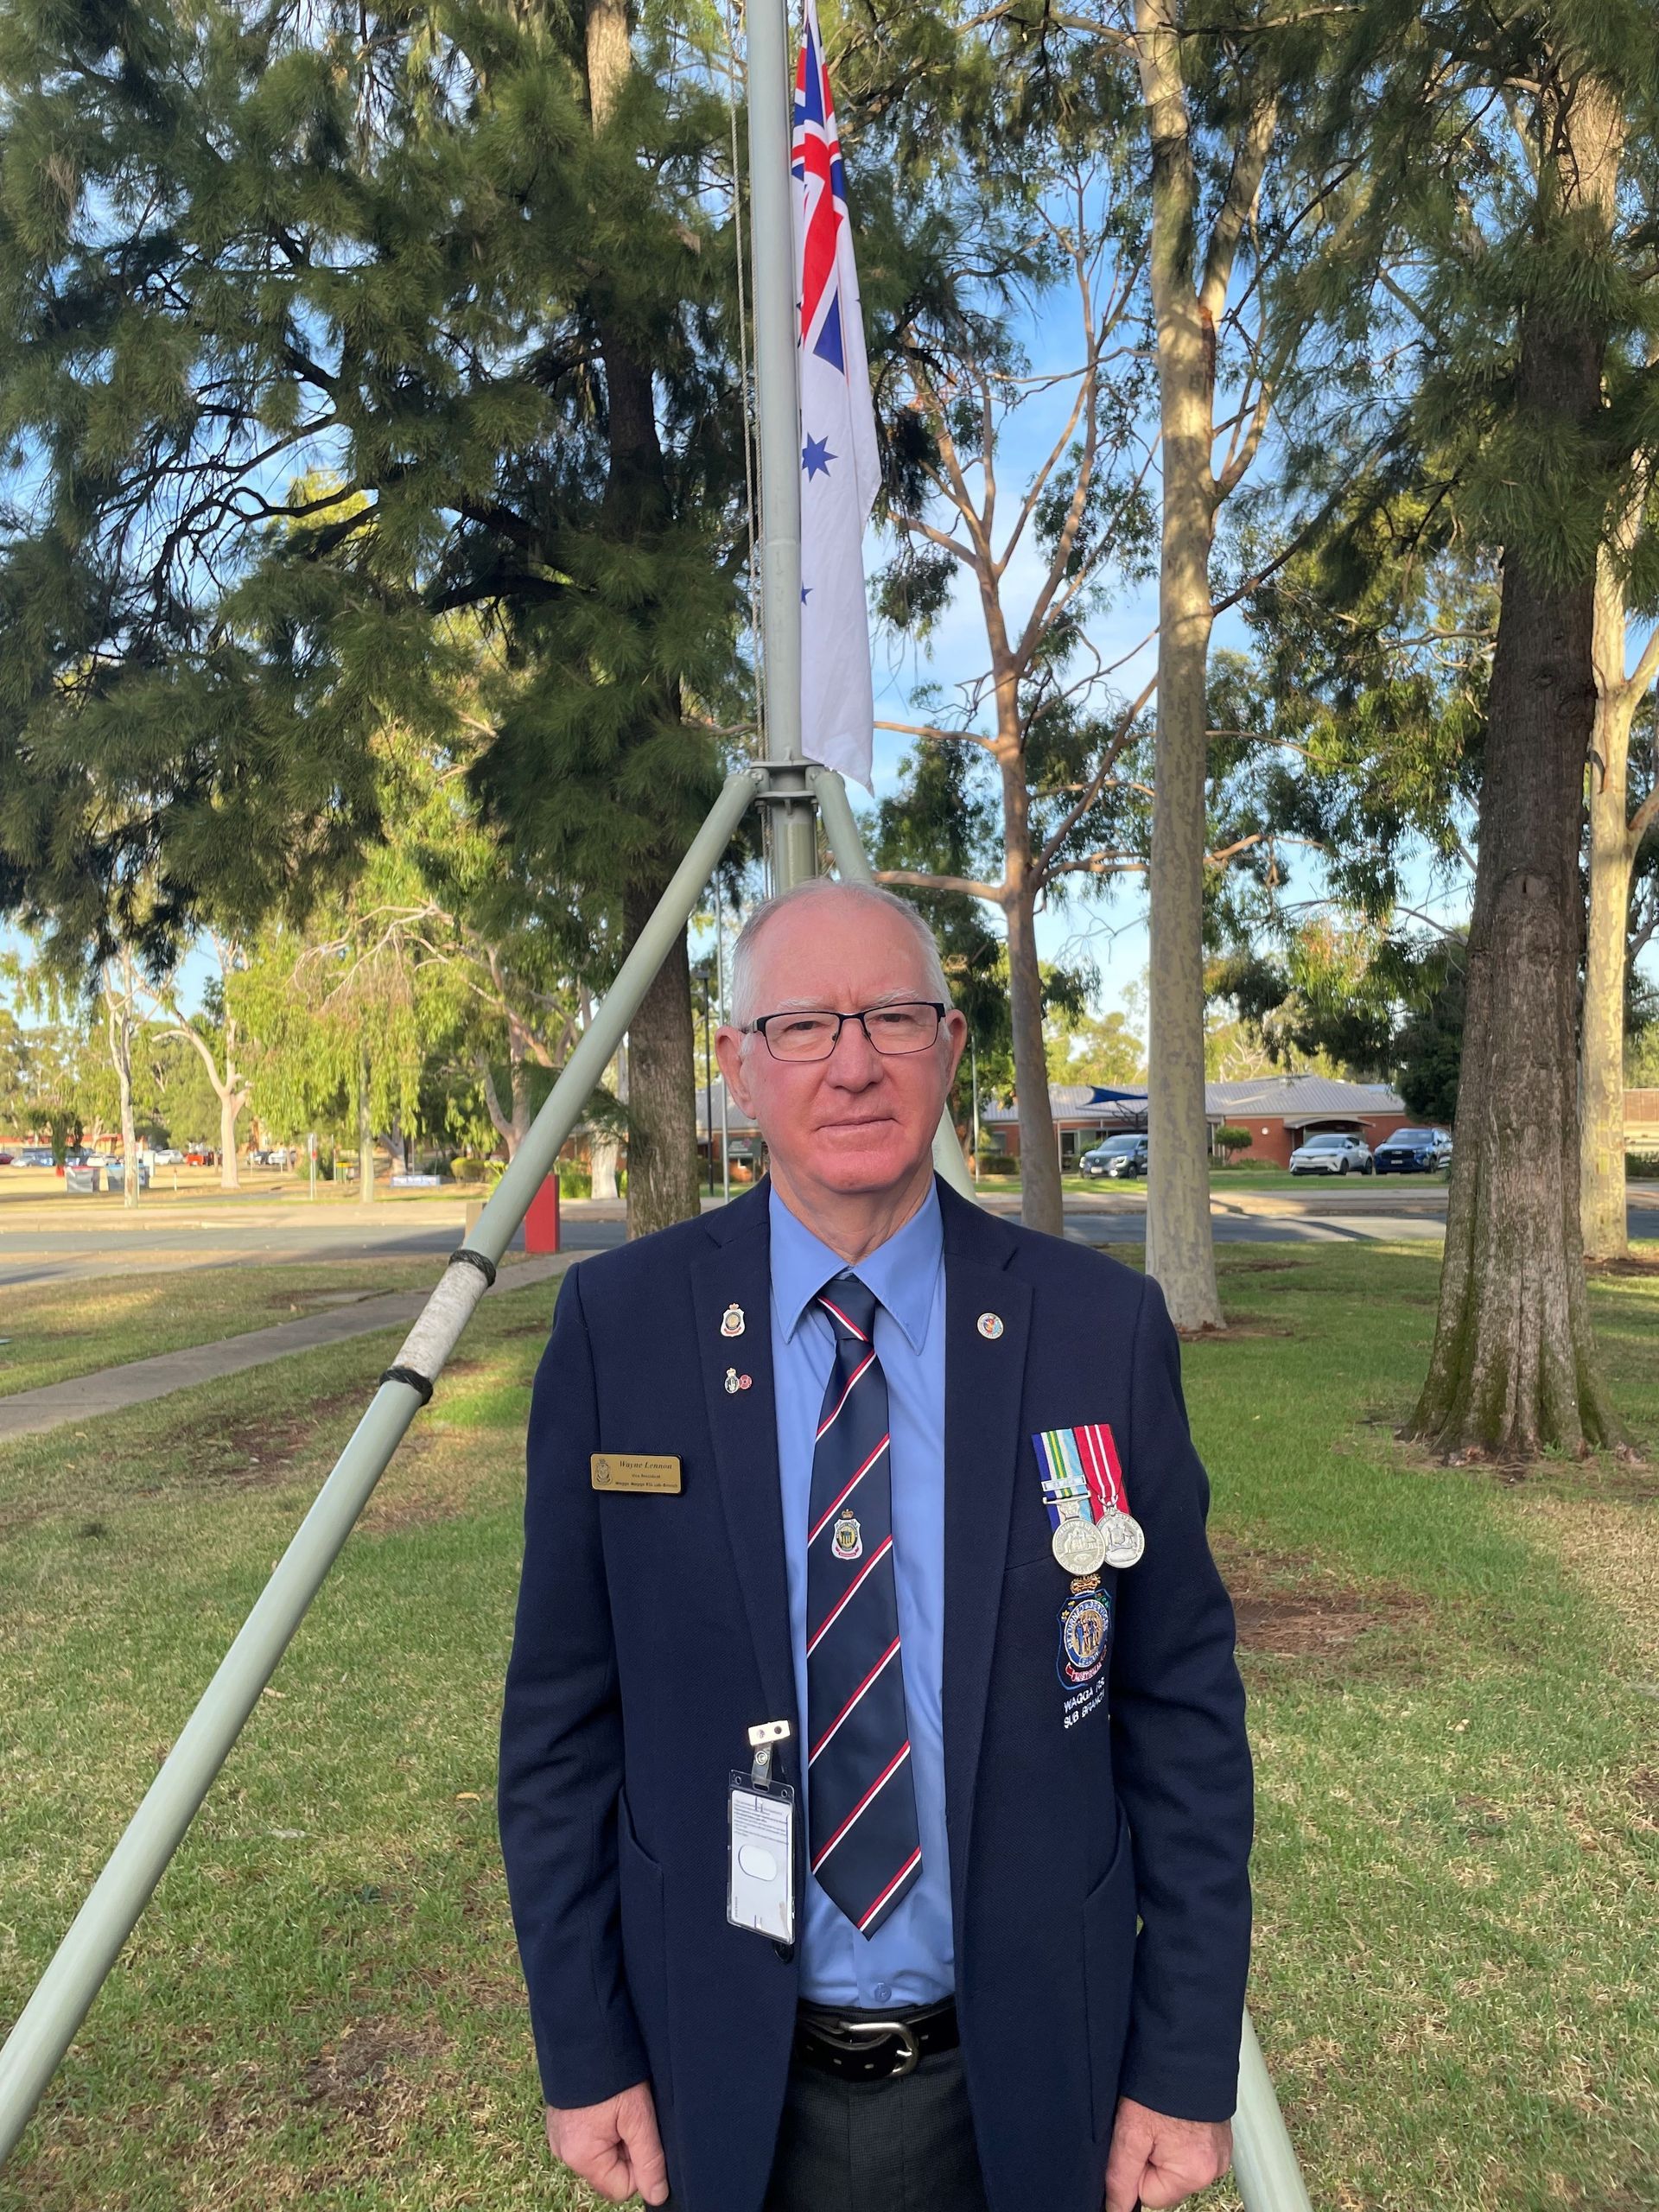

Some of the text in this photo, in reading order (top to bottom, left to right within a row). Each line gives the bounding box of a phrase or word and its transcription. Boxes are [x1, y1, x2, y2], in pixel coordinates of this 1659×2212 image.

[620, 1460, 672, 1470] Wayne Lennon
[1064, 1676, 1105, 1714] WAGGA RS
[1064, 1688, 1105, 1728] SUB BRANCH
